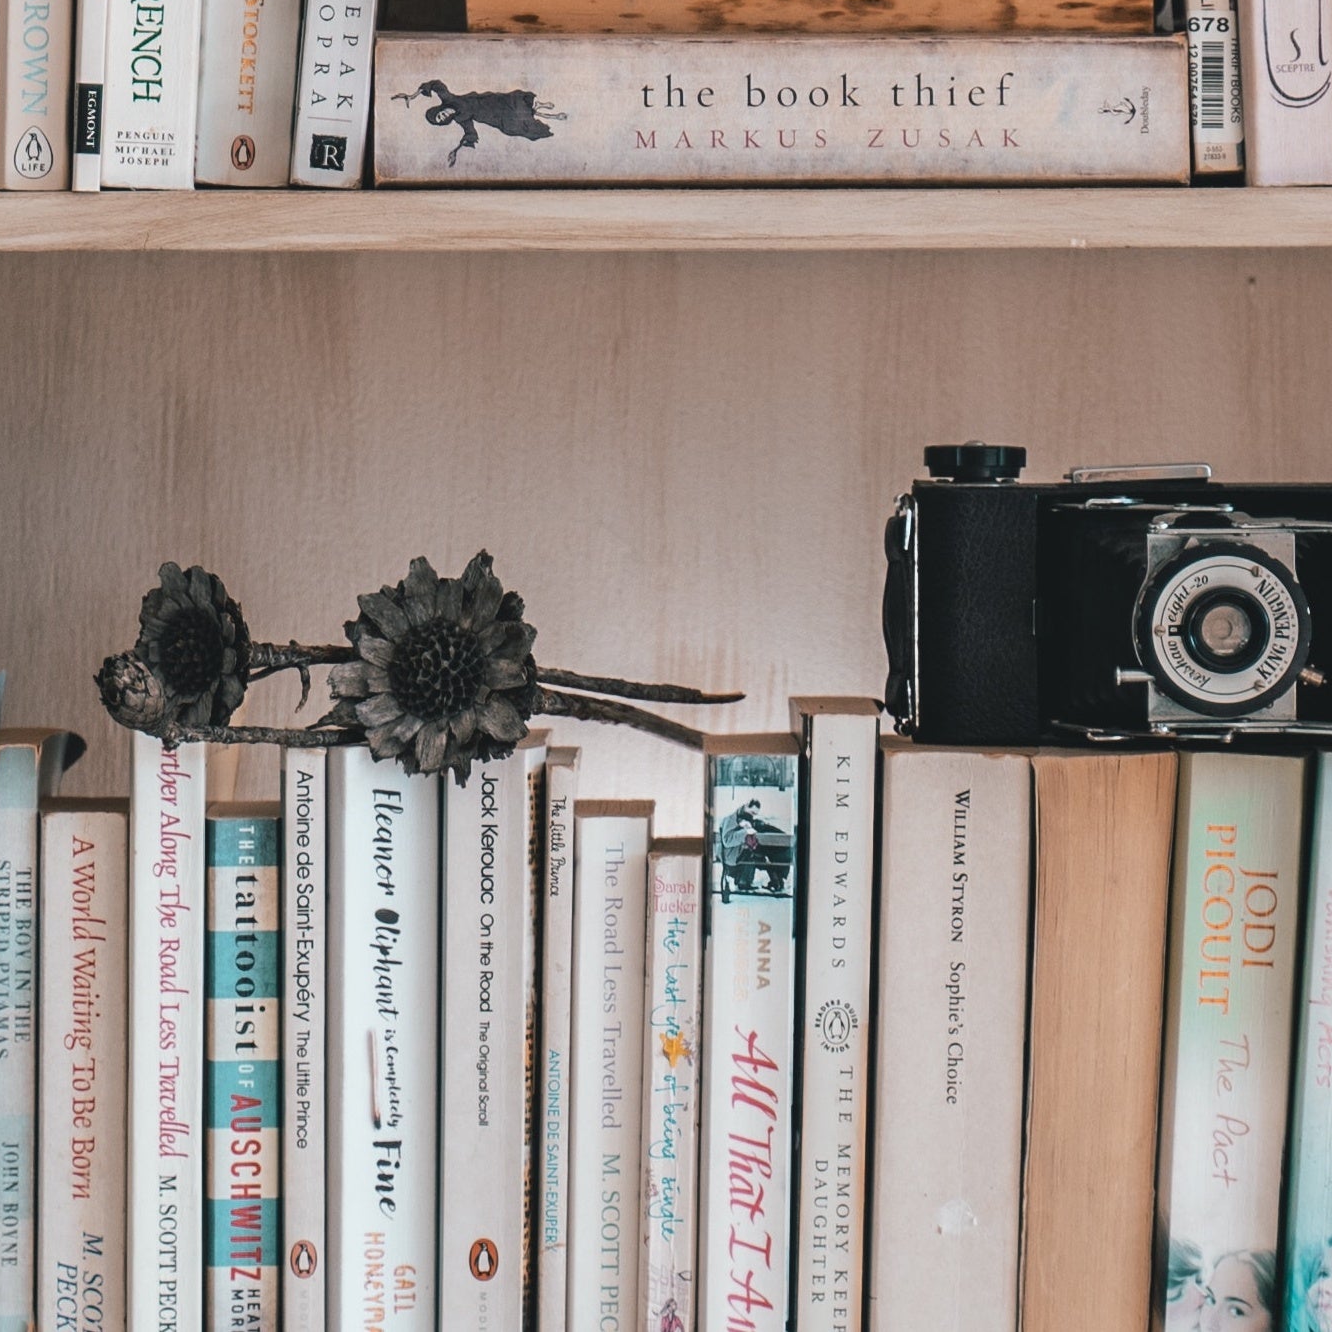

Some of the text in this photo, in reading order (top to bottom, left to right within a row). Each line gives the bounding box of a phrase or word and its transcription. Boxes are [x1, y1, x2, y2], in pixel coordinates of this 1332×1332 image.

[83, 90, 98, 148] EGMONT
[636, 129, 1021, 149] MARKUS ZUSAK
[642, 74, 1017, 108] the book thief
[1256, 578, 1291, 640] PENGUIN
[1256, 642, 1287, 682] KING
[476, 772, 498, 1126] Jack Kerouac On the Road The Original Scroll
[831, 755, 850, 970] KIM EDWARDS
[945, 789, 970, 1105] WILLIAM STYRON Sophie's Choice
[1197, 823, 1238, 1015] PICOULT
[1238, 867, 1278, 968] JODI
[64, 836, 106, 1200] A World Waiting To Be Born
[230, 825, 266, 1281] THE tattooist OF AUSCHWITZ
[291, 770, 315, 1149] Antoine de Saint-Exupéry The Little Prince
[369, 788, 402, 1220] Eleanor Oliphant is Completely Fine
[1212, 1034, 1250, 1188] The Pact
